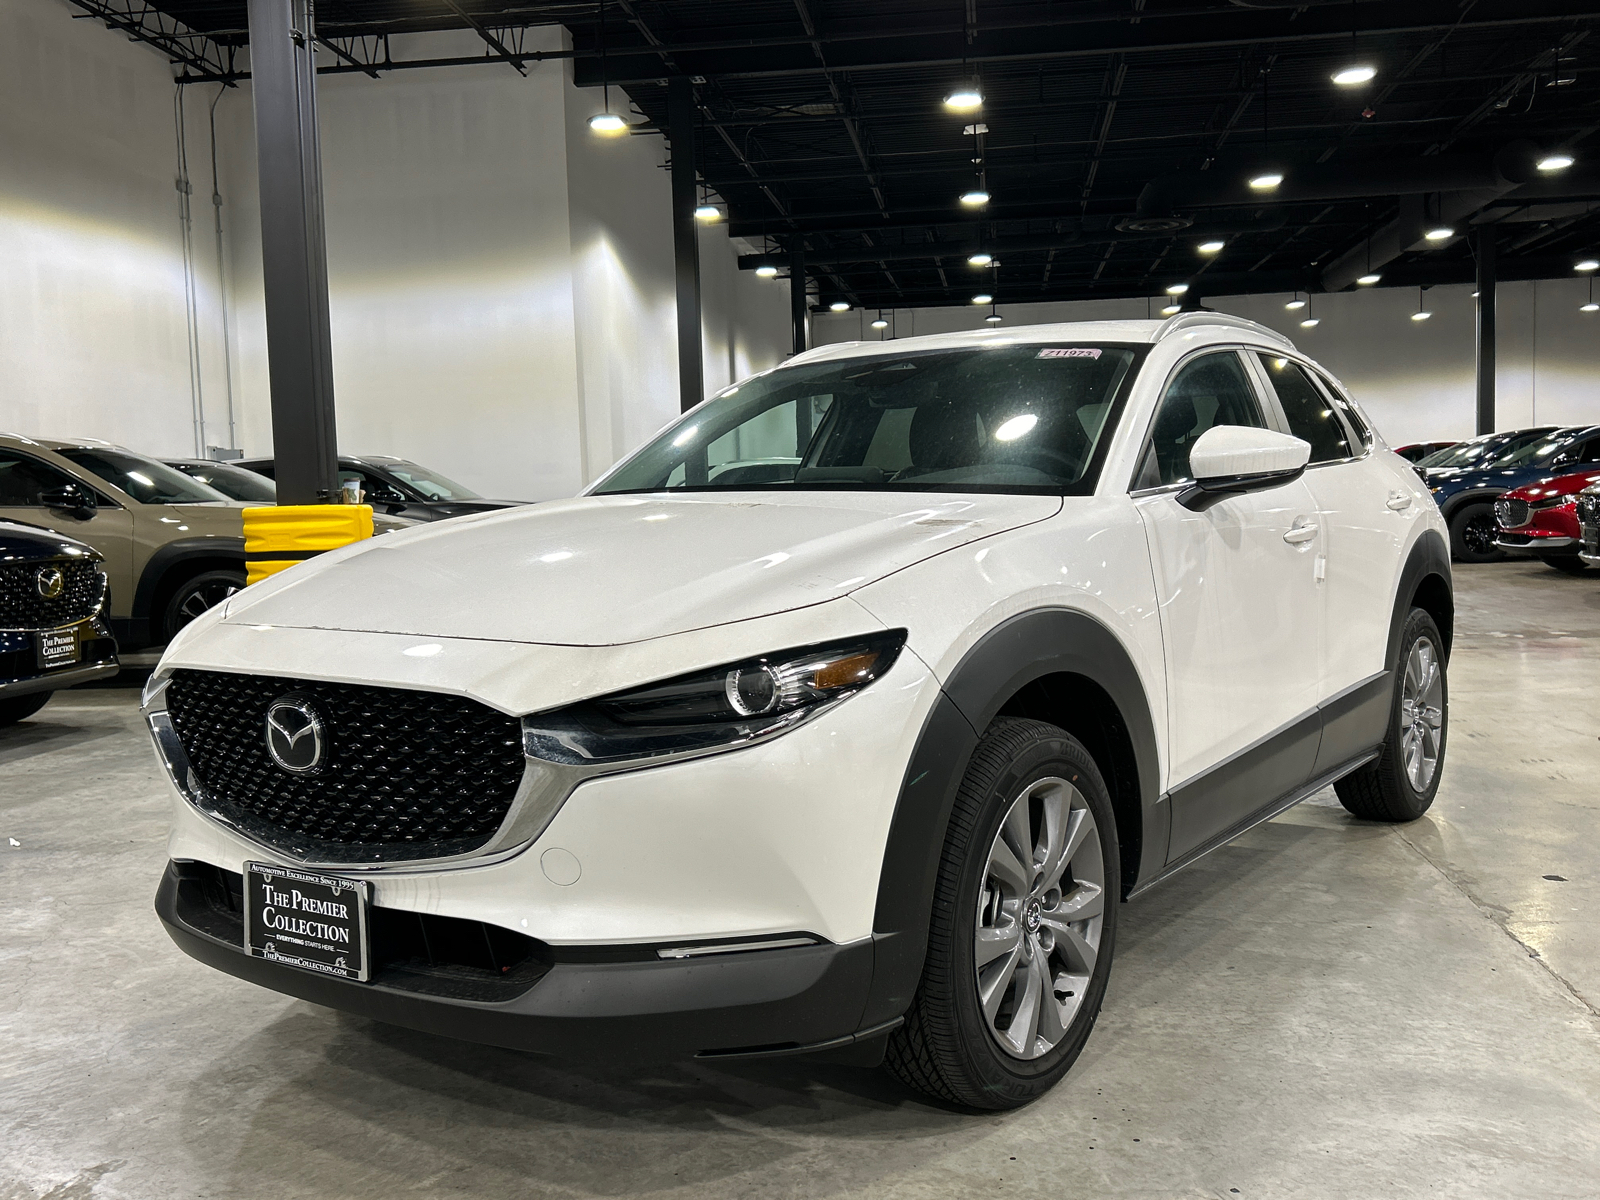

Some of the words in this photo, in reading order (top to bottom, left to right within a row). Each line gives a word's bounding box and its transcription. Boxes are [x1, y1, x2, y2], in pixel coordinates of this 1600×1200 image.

[42, 638, 54, 647] THE
[42, 644, 75, 656] COLLECTION
[251, 864, 286, 877] AUTOMOTIVE
[286, 871, 319, 883] EXCELLENCE
[320, 877, 336, 887] SINCE
[338, 880, 354, 890] 1995
[262, 884, 290, 908] THE
[291, 889, 349, 920] PREMIER
[262, 906, 349, 944] COLLECTION
[276, 934, 304, 946] EVERYTHING
[304, 941, 321, 950] STARTS
[321, 944, 335, 952] HERE
